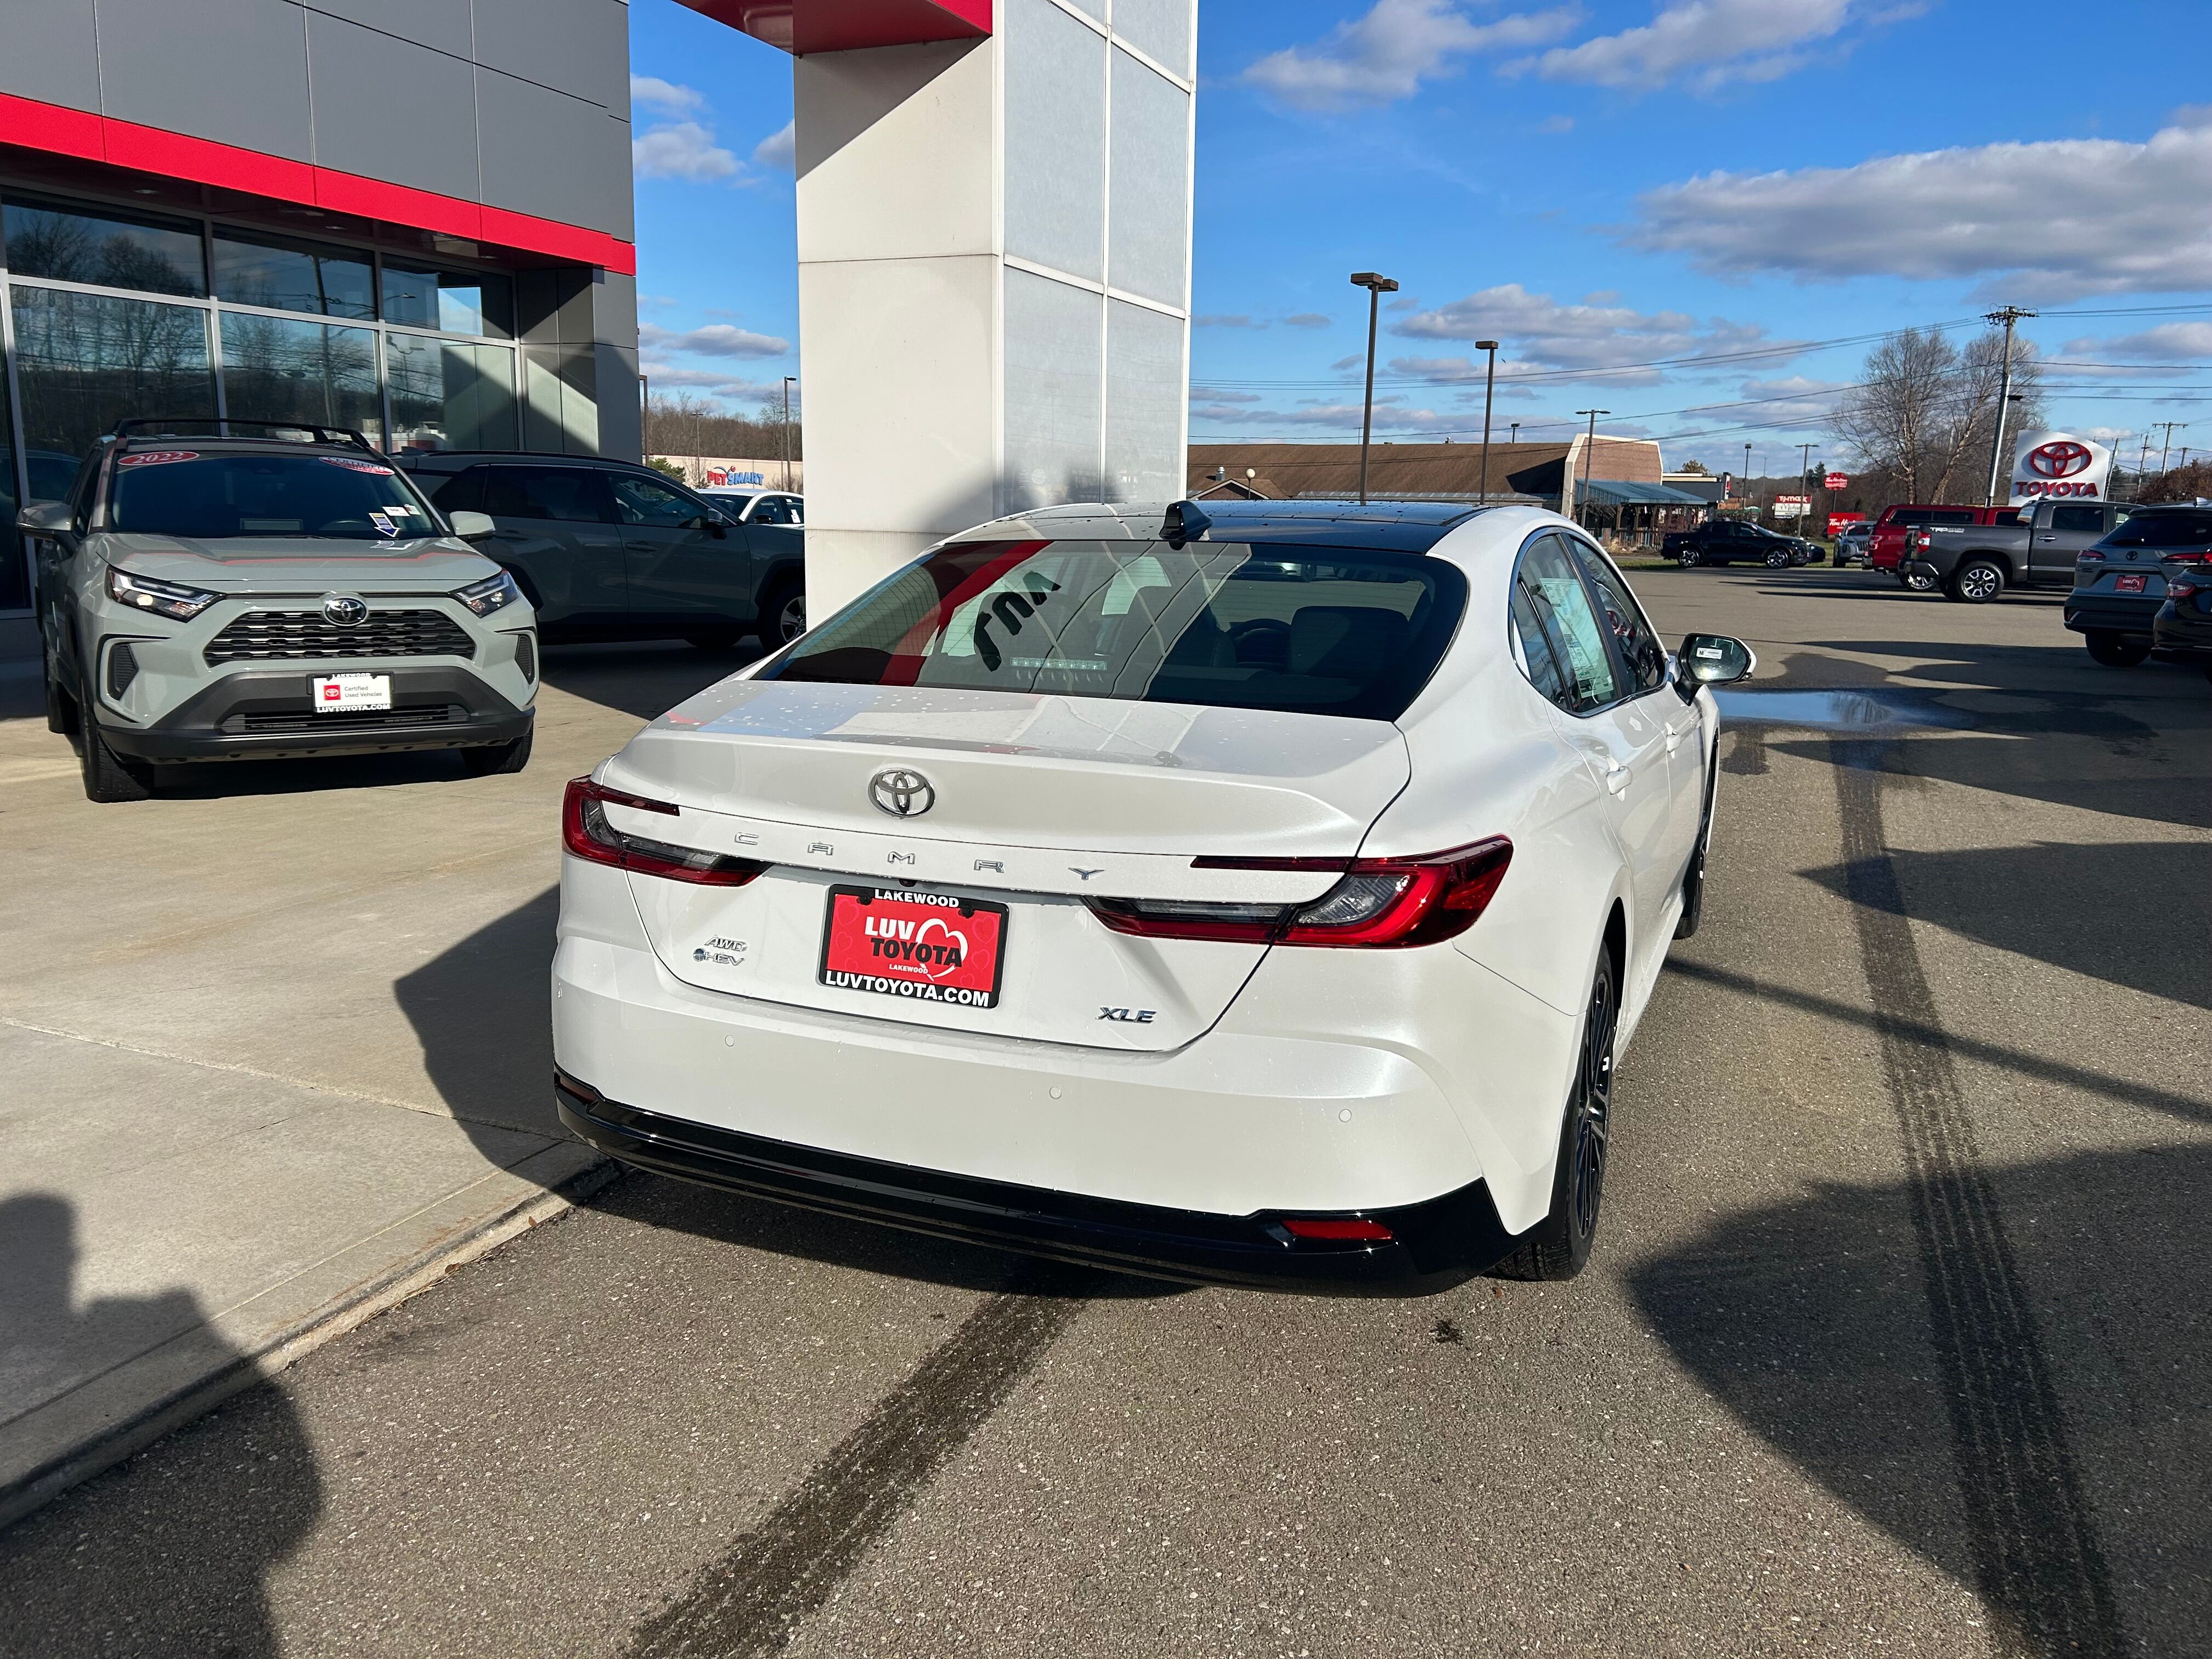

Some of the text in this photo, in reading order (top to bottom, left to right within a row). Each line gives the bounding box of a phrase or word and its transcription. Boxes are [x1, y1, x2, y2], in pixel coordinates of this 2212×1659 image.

[132, 452, 183, 464] 2022
[2016, 481, 2098, 496] TOYOTA
[317, 703, 390, 713] LUVTOYOTA.COM
[734, 827, 1105, 881] CAMRY
[874, 889, 959, 908] LAKEWOOD
[865, 916, 916, 940] LUV
[704, 936, 747, 952] AWD
[704, 952, 746, 966] HEV
[871, 938, 962, 967] TOYOTA
[889, 963, 928, 974] LAKEWOOD
[825, 970, 989, 1007] LUVTOYOTA.COM
[1095, 1007, 1157, 1024] XLE
